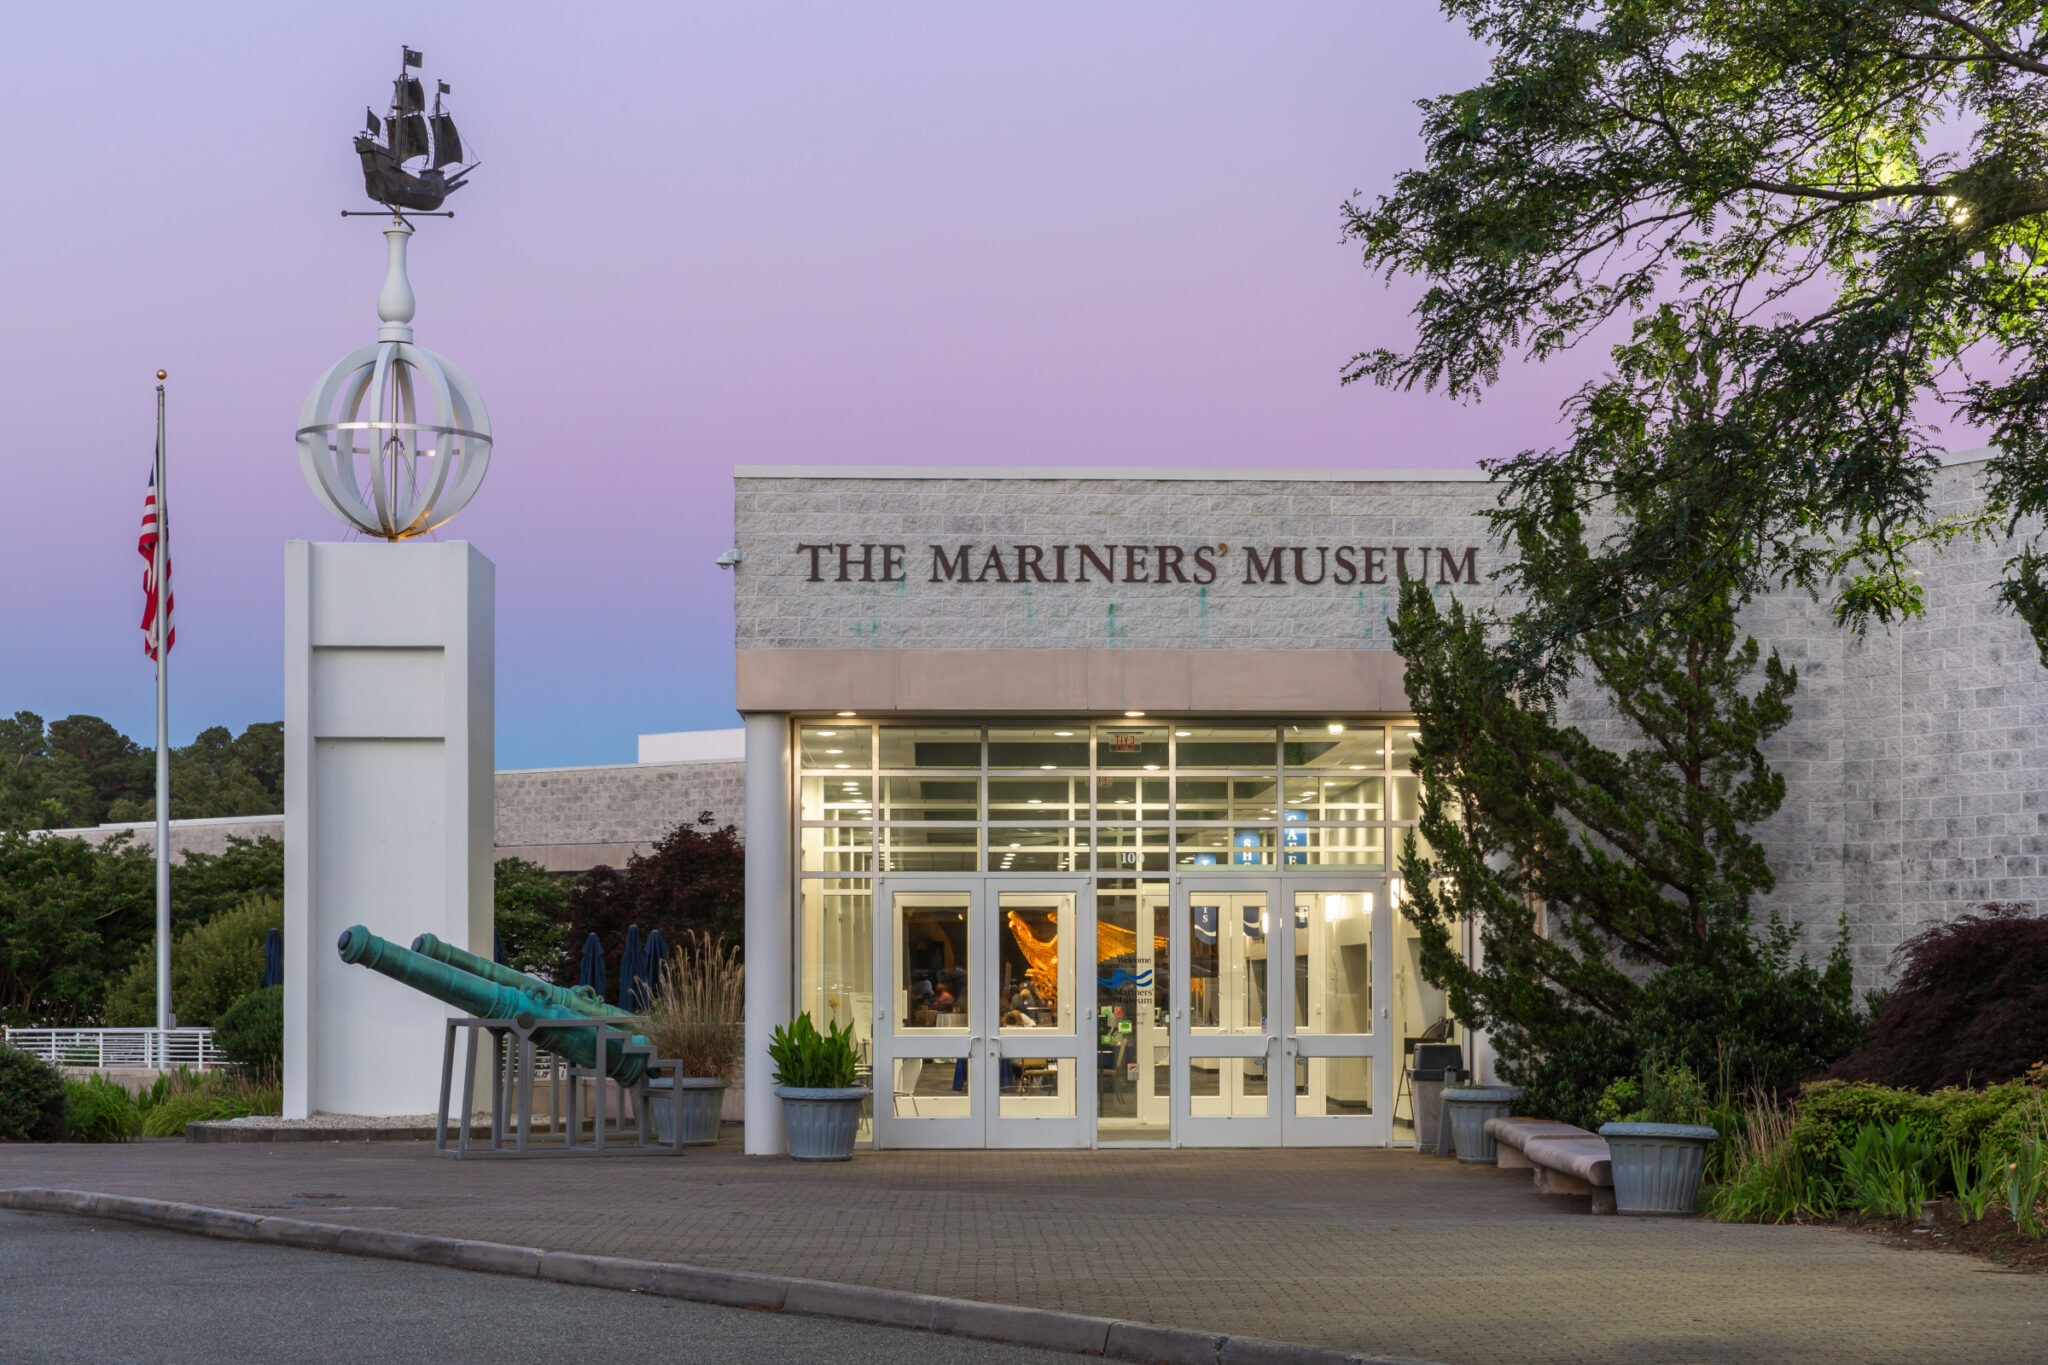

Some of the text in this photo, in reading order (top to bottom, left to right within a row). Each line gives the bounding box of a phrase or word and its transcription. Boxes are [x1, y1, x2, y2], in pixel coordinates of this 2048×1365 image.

[797, 543, 1480, 585] THE MARINERS' MUSEUM
[1121, 852, 1145, 864] 100
